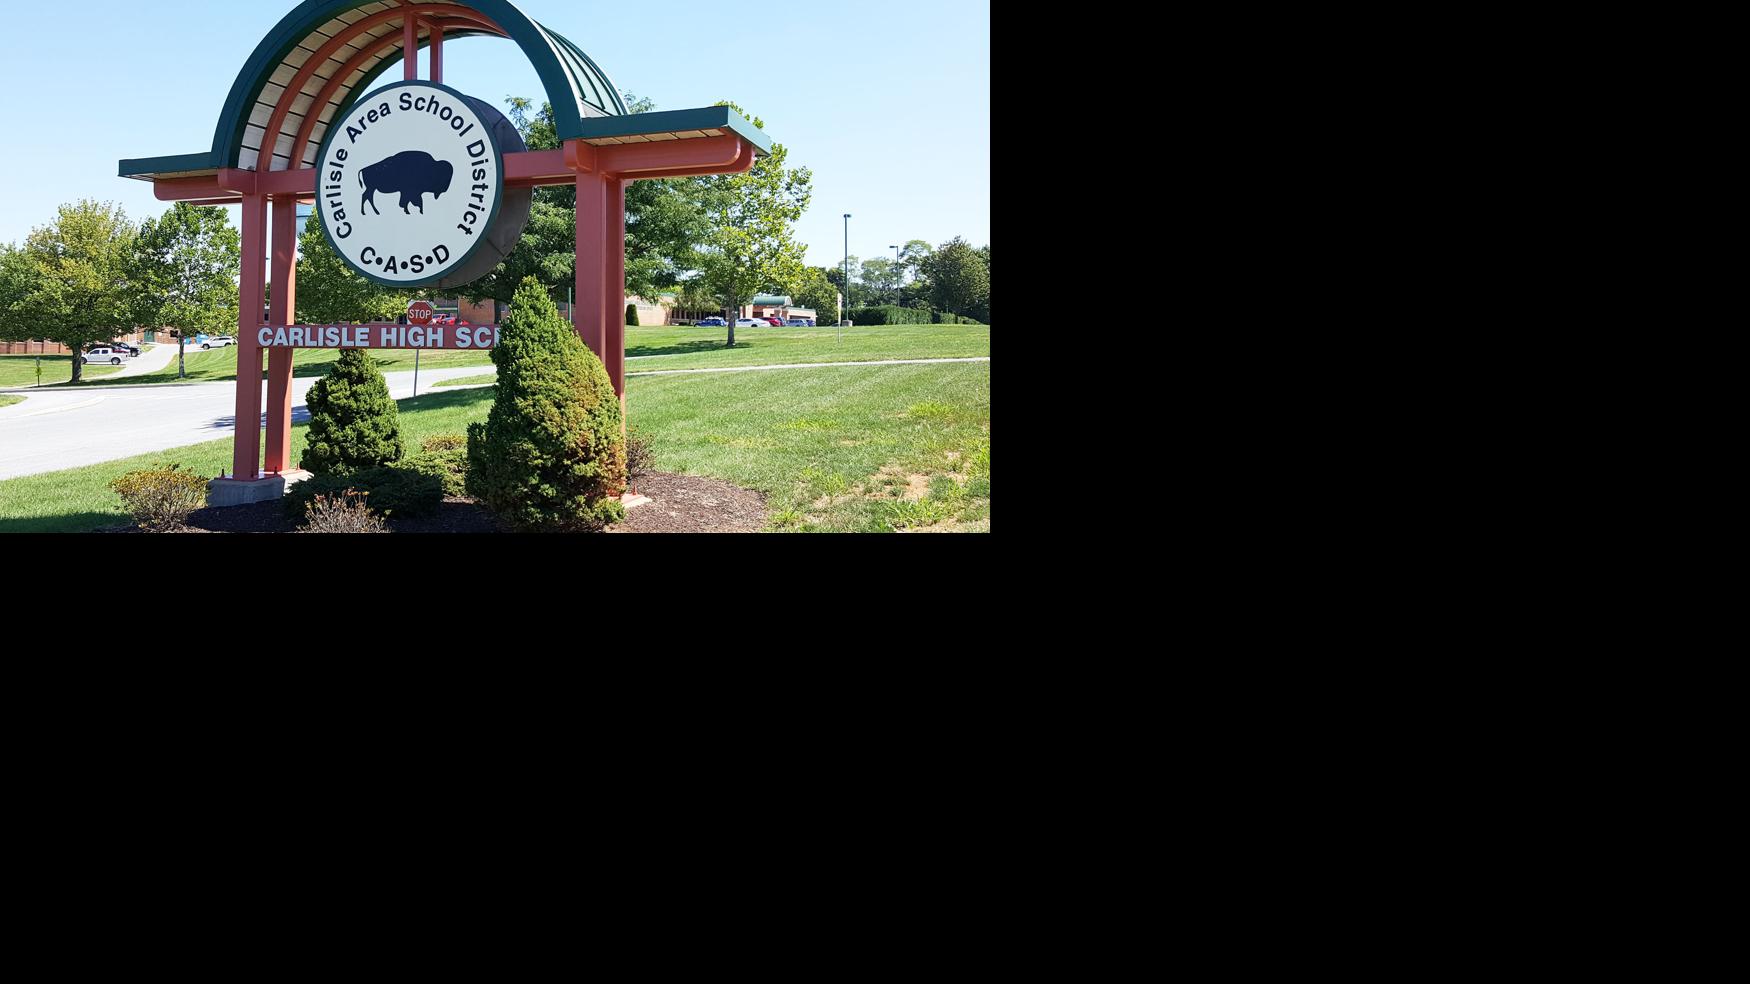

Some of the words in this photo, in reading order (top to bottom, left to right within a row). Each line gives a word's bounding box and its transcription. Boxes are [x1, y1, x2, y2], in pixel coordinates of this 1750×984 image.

[325, 148, 352, 239] Carlisle
[346, 102, 391, 143] Area
[399, 92, 474, 138] School
[457, 139, 489, 236] District
[409, 309, 432, 319] STOP
[257, 327, 370, 347] CARLISLE
[381, 326, 443, 348] HIGH
